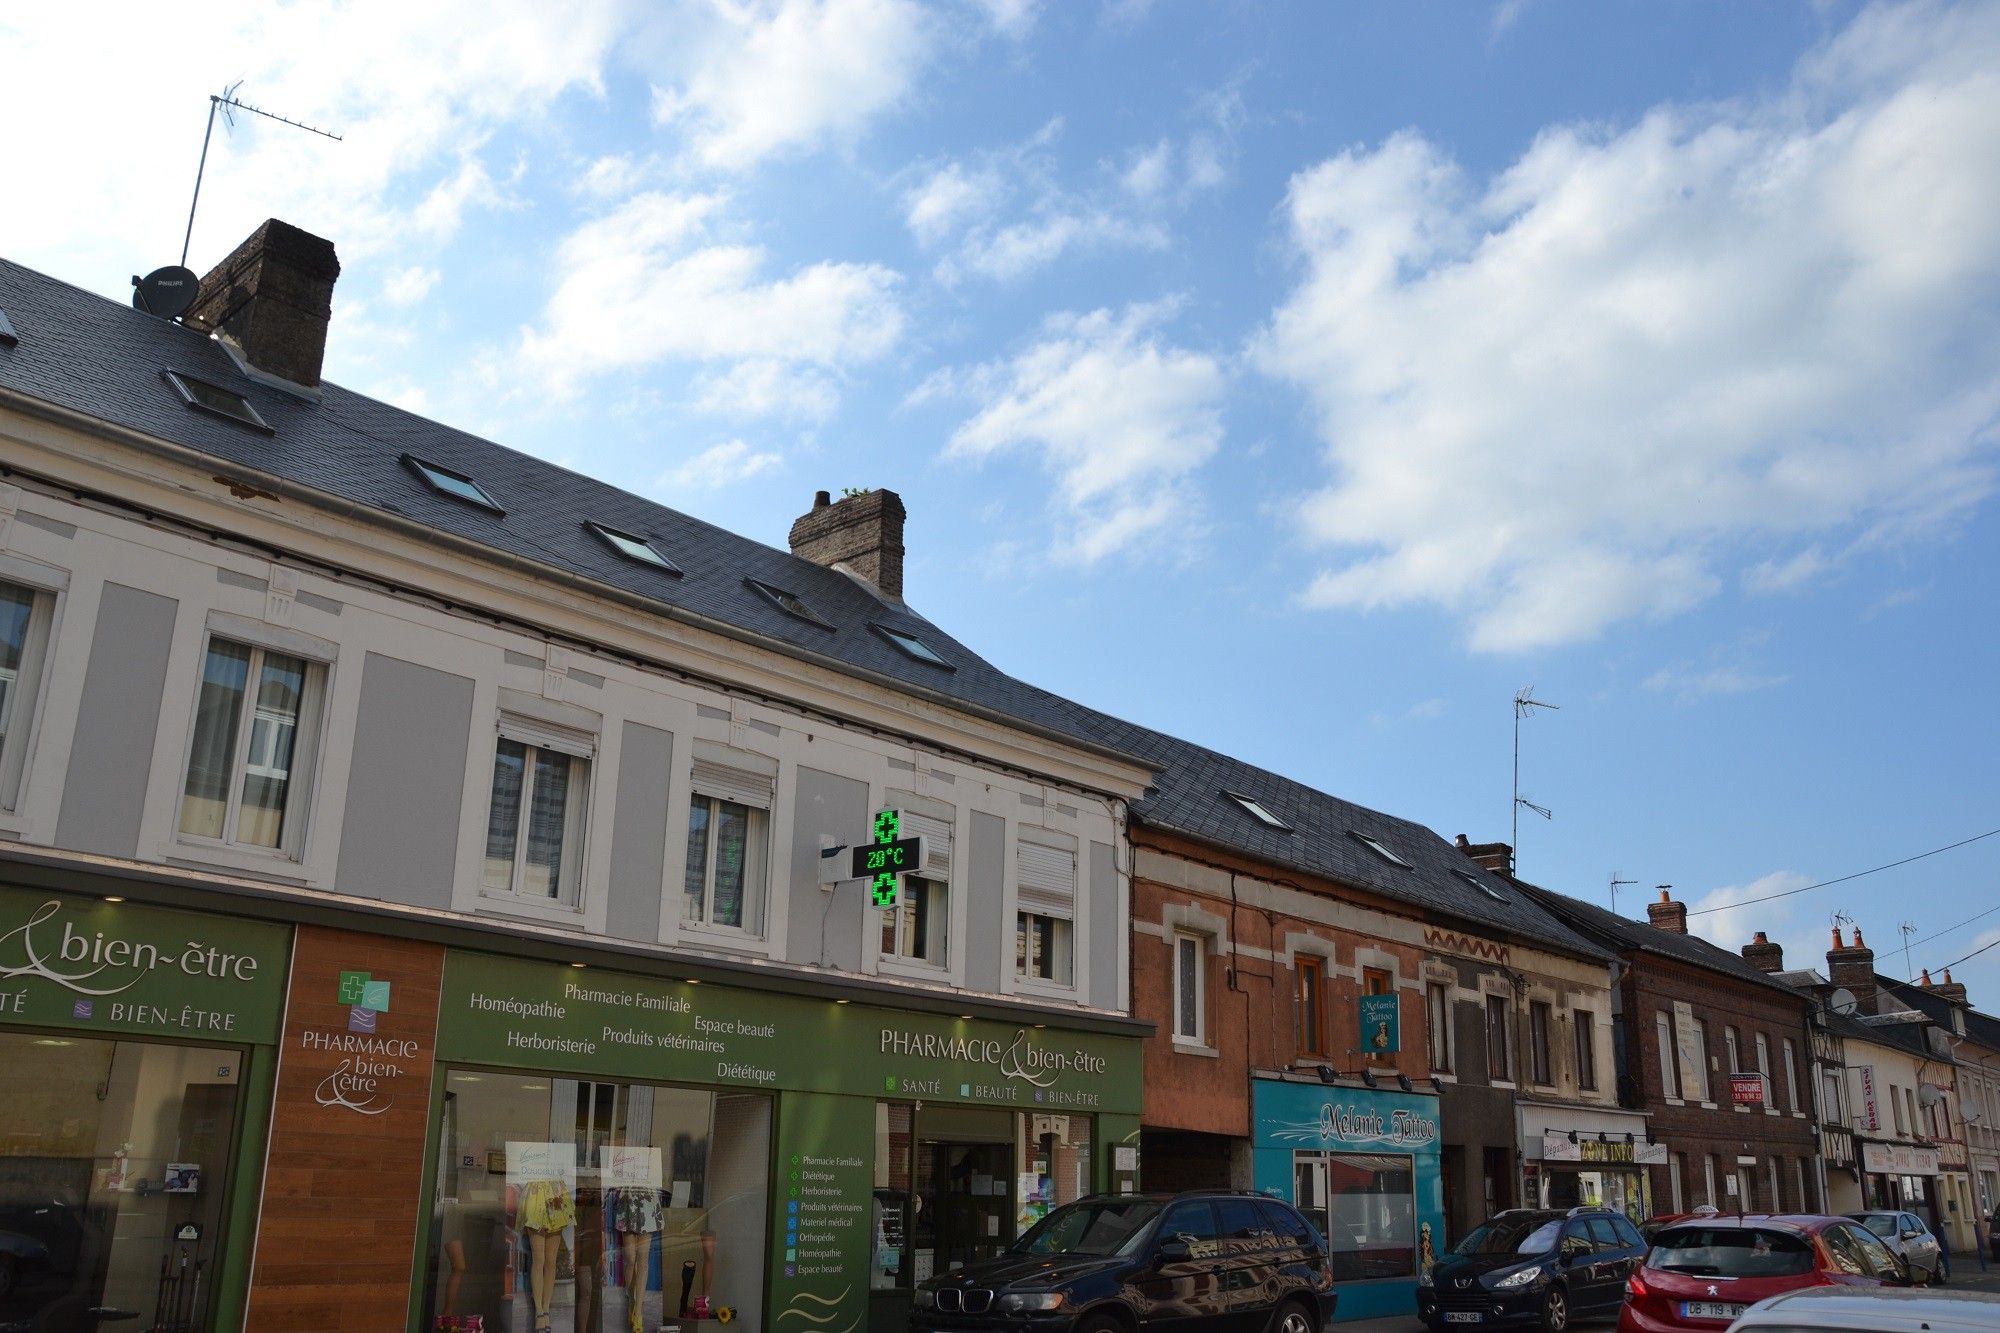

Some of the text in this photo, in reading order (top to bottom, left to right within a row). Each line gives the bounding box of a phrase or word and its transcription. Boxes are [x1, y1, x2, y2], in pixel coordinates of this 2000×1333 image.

[867, 848, 903, 868] 20°C
[60, 922, 258, 980] bien-être
[470, 993, 566, 1019] Homéopathie
[565, 983, 691, 1014] Pharmacie Familiale
[1361, 1000, 1395, 1012] Melanie
[110, 1003, 236, 1031] BIEN-ÊTRE
[1367, 1012, 1393, 1023] Tattoo
[694, 1015, 775, 1038] Espace beauté
[302, 1031, 418, 1058] PHARMACIE
[507, 1031, 596, 1055] Herboristerie
[602, 1026, 725, 1053] Produits vétérinaires
[881, 1029, 1000, 1064] PHARMACIE
[1027, 1043, 1106, 1074] bien-être
[355, 1056, 403, 1078] bien-
[717, 1062, 776, 1085] Diététique
[339, 1073, 377, 1092] être
[902, 1078, 941, 1095] SANTÉ
[1733, 1082, 1762, 1092] VENDRE
[975, 1085, 1017, 1100] BEAUTÉ
[1049, 1089, 1099, 1106] BIEN-ÊTRE
[1321, 1103, 1436, 1145] Melanie Tattoo
[1611, 1143, 1633, 1160] INFO
[803, 1155, 863, 1168] Pharmacie Familiale
[802, 1171, 835, 1182] Diététique
[801, 1187, 842, 1196] Herboristerie
[801, 1202, 863, 1212] Produits vétérinaires
[827, 1217, 853, 1227] médical
[799, 1233, 836, 1244] Orthopédie
[798, 1248, 842, 1259] Homéopathie
[798, 1264, 843, 1275] Espace beauté
